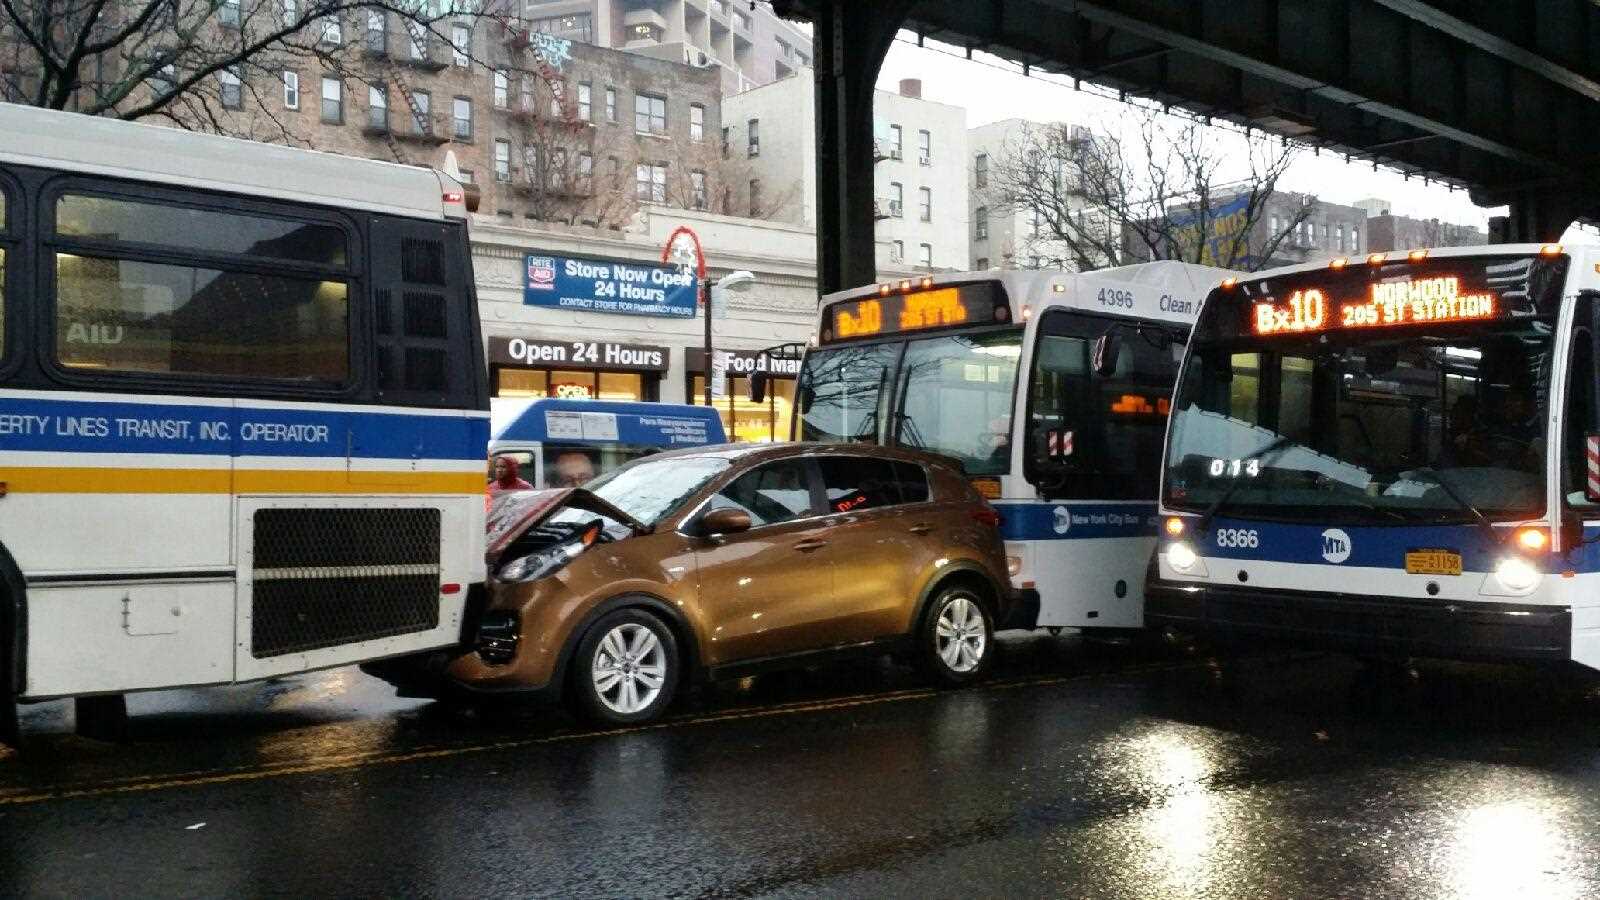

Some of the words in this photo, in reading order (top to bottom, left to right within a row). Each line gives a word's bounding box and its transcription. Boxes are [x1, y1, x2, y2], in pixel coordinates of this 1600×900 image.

[565, 259, 609, 278] Store
[613, 264, 648, 282] Now
[652, 268, 692, 289] Open
[594, 280, 616, 298] 24
[619, 282, 665, 302] Hours
[1097, 287, 1134, 309] 4396
[1372, 277, 1459, 304] NORWOOD
[559, 297, 594, 308] CONTACT
[594, 300, 618, 310] STORE
[618, 301, 634, 311] FOR
[1159, 294, 1192, 314] Clean
[1256, 289, 1324, 333] Bx10
[1342, 304, 1379, 326] 205
[1383, 302, 1406, 323] ST
[1412, 294, 1492, 320] STATION
[508, 338, 566, 365] Open
[572, 342, 599, 363] 24
[605, 343, 663, 366] Hours
[726, 352, 767, 372] Food
[0, 414, 50, 436] ERTY
[56, 415, 110, 437] LINES
[115, 417, 195, 442] TRANSIT,
[200, 421, 231, 441] INC.
[240, 422, 329, 443] OPERATOR
[1216, 527, 1259, 549] 8366
